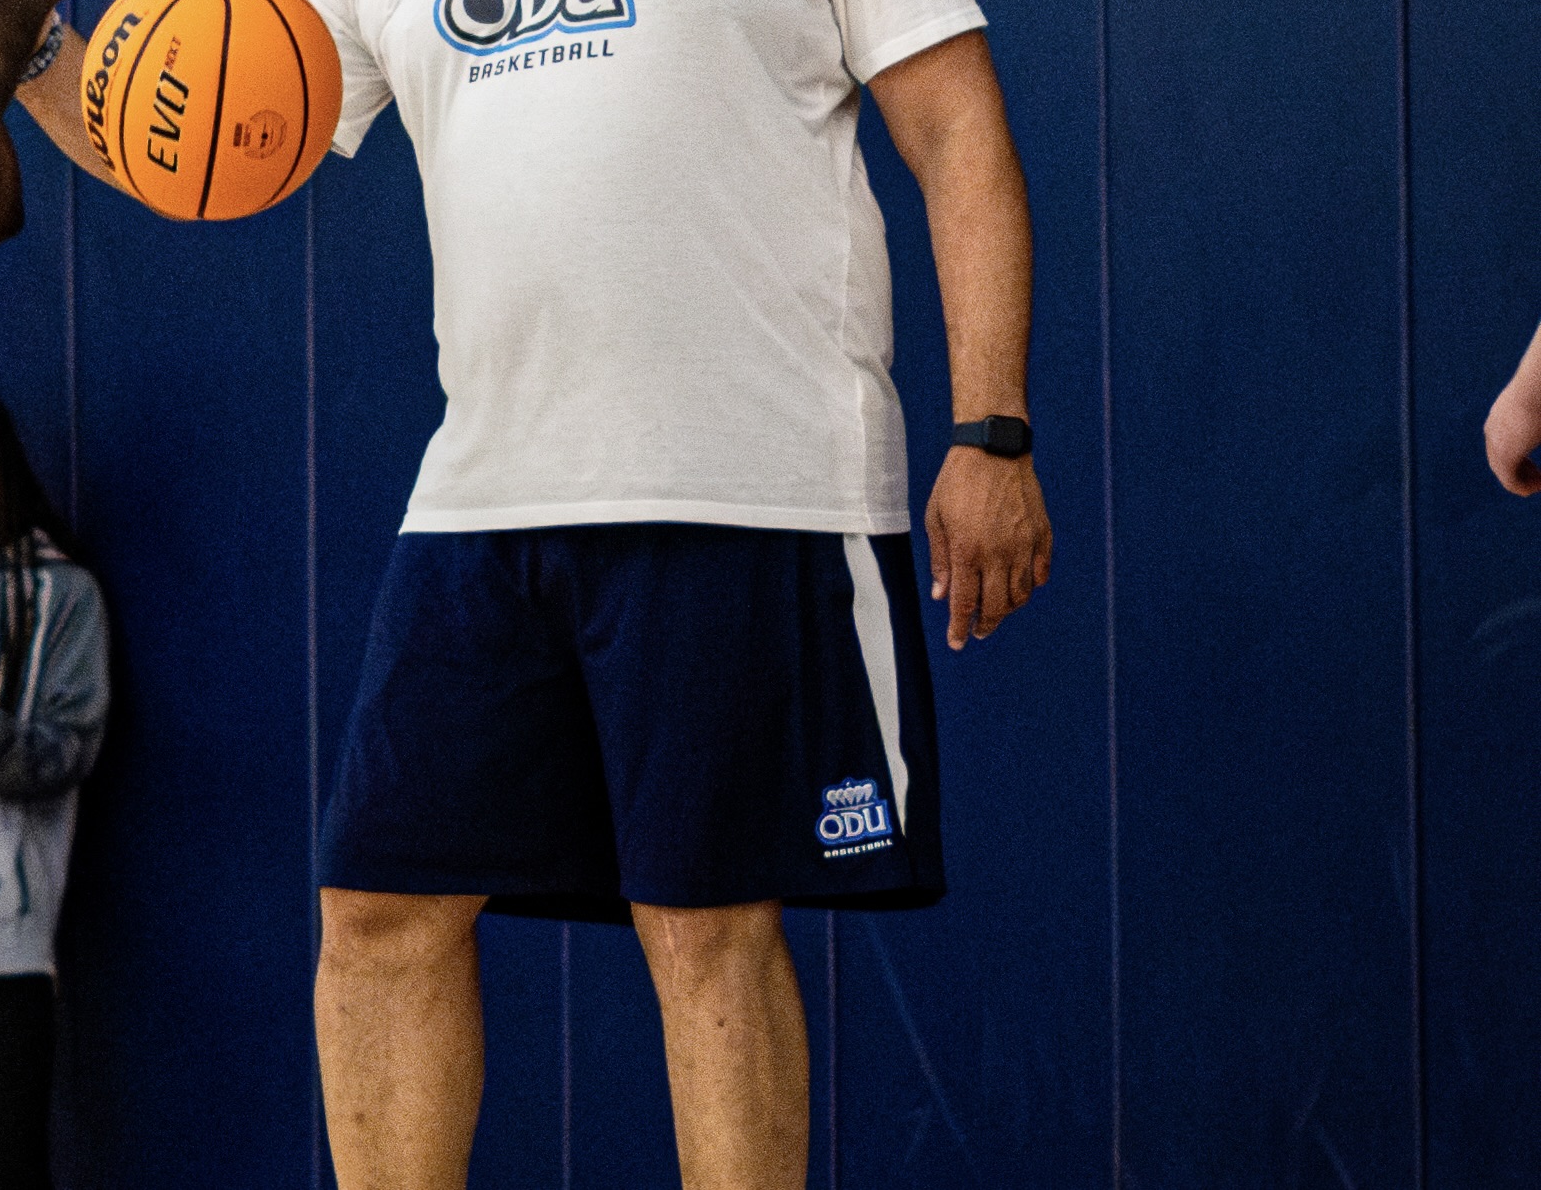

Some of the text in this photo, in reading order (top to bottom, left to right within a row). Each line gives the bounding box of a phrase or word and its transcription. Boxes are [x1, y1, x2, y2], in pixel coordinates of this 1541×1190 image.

[469, 39, 615, 84] BASKETBALL
[147, 70, 190, 174] EVO
[819, 805, 887, 840] ODU
[823, 838, 893, 858] BASKETBALL
